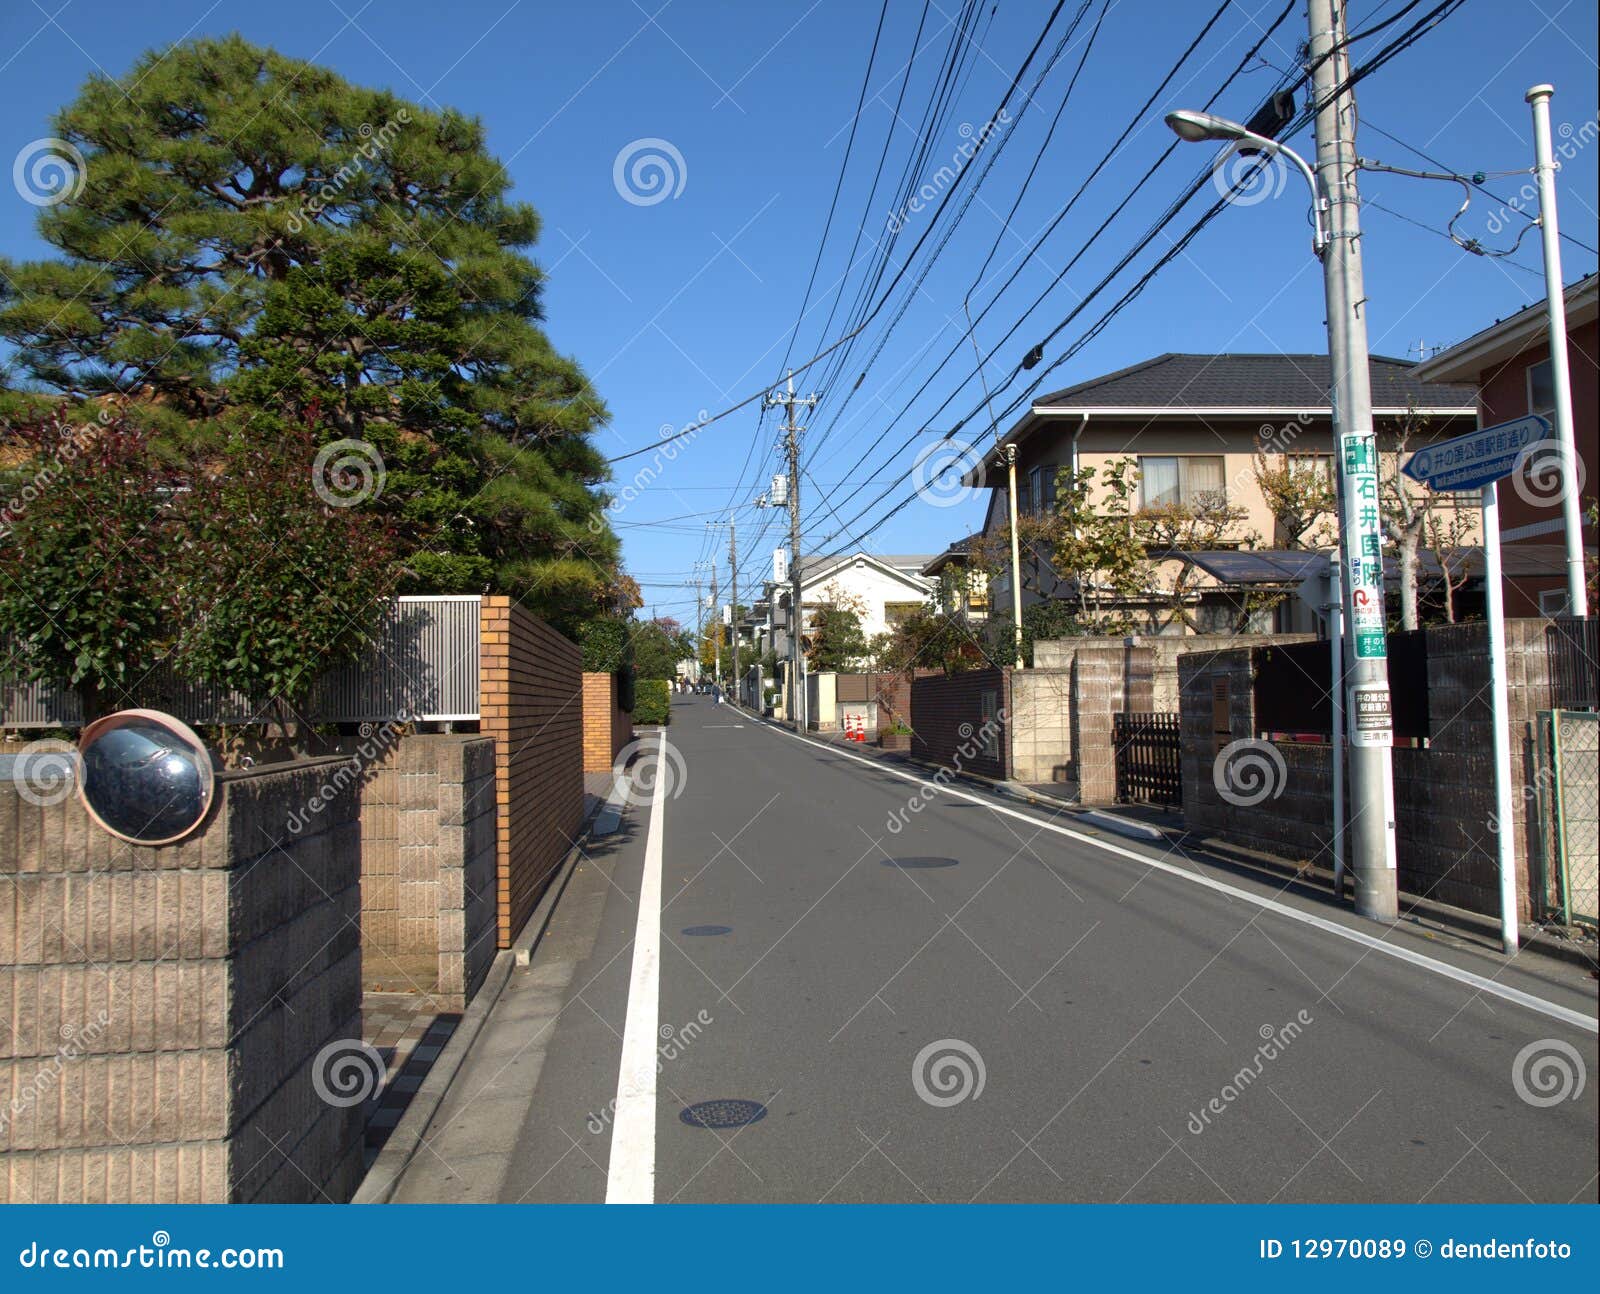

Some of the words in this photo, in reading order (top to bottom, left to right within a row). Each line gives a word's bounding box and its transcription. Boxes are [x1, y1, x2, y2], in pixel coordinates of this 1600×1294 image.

[1433, 426, 1530, 471] 井の頭公園駅前通り
[1357, 477, 1381, 586] 石井医院
